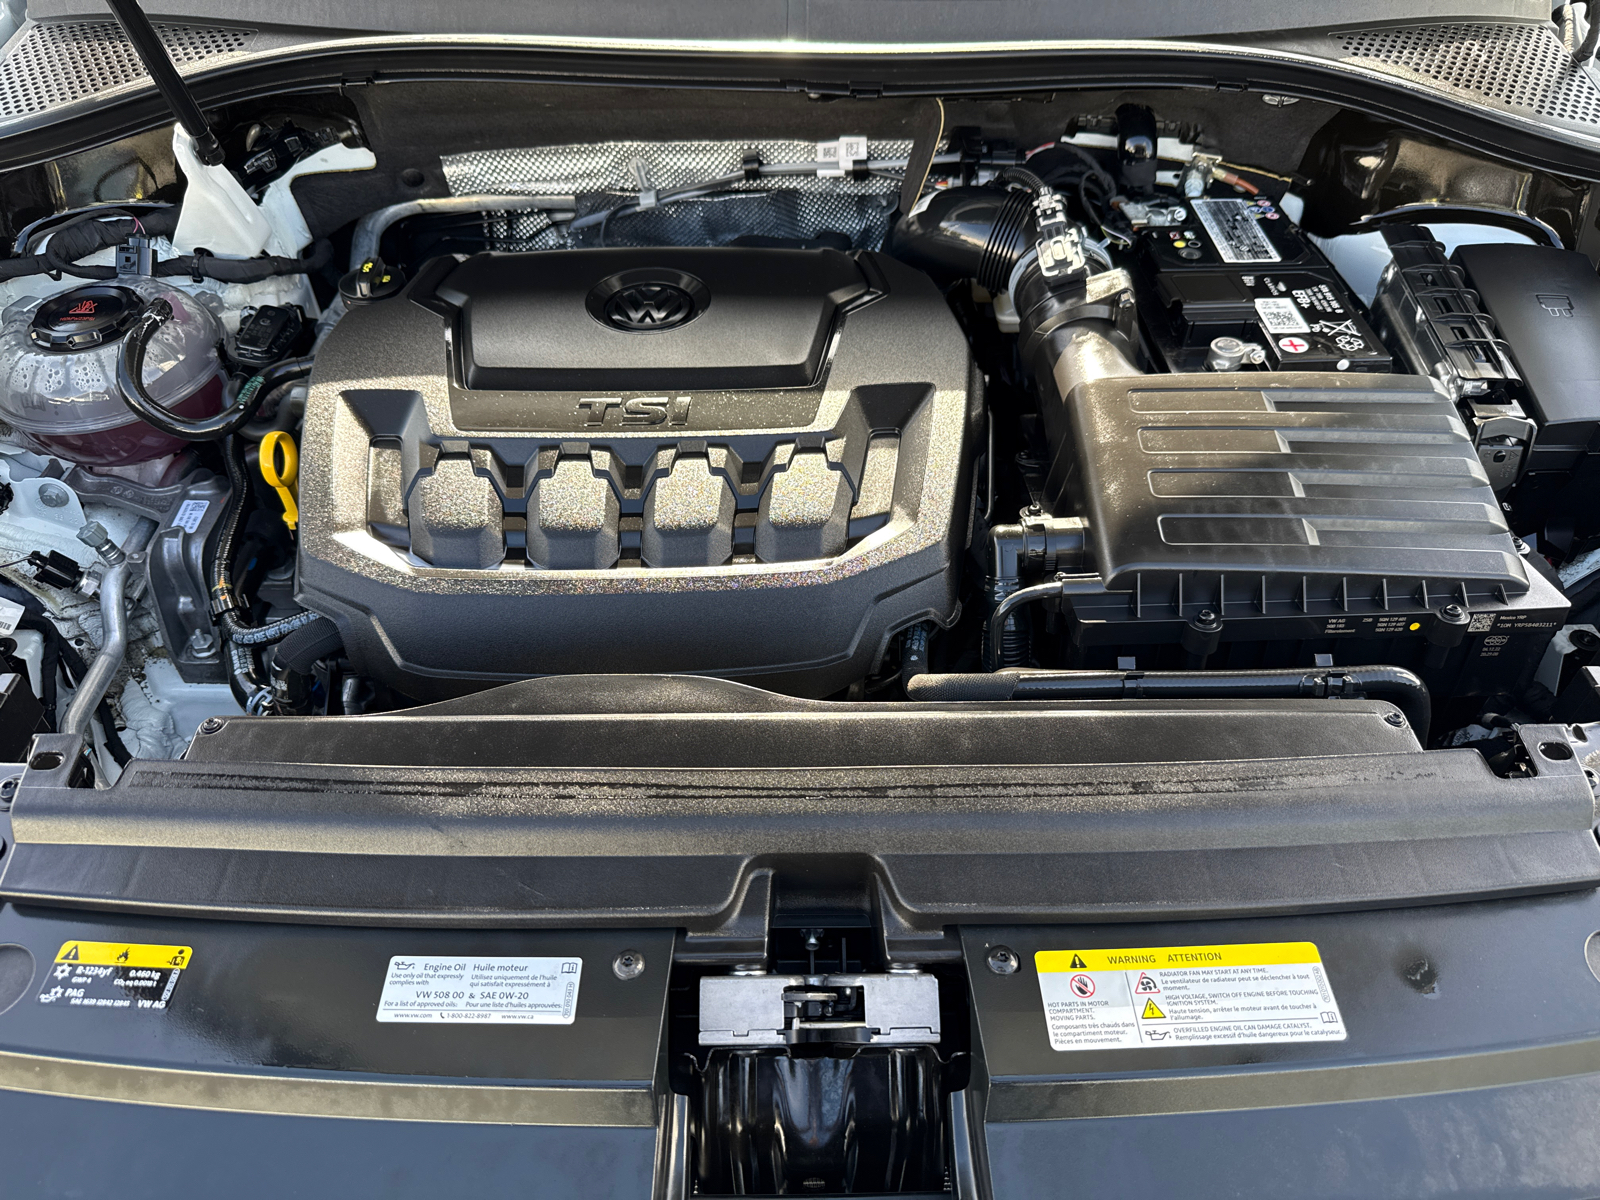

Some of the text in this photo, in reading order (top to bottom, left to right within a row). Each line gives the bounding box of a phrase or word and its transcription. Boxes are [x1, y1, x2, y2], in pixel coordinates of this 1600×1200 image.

[577, 396, 692, 426] TSI
[1107, 952, 1222, 964] WARNING ATTENTION
[76, 966, 113, 978] R-1234yf
[424, 963, 452, 972] Engine
[151, 970, 161, 980] kg
[65, 988, 85, 998] PAG
[138, 999, 166, 1009] VW AG
